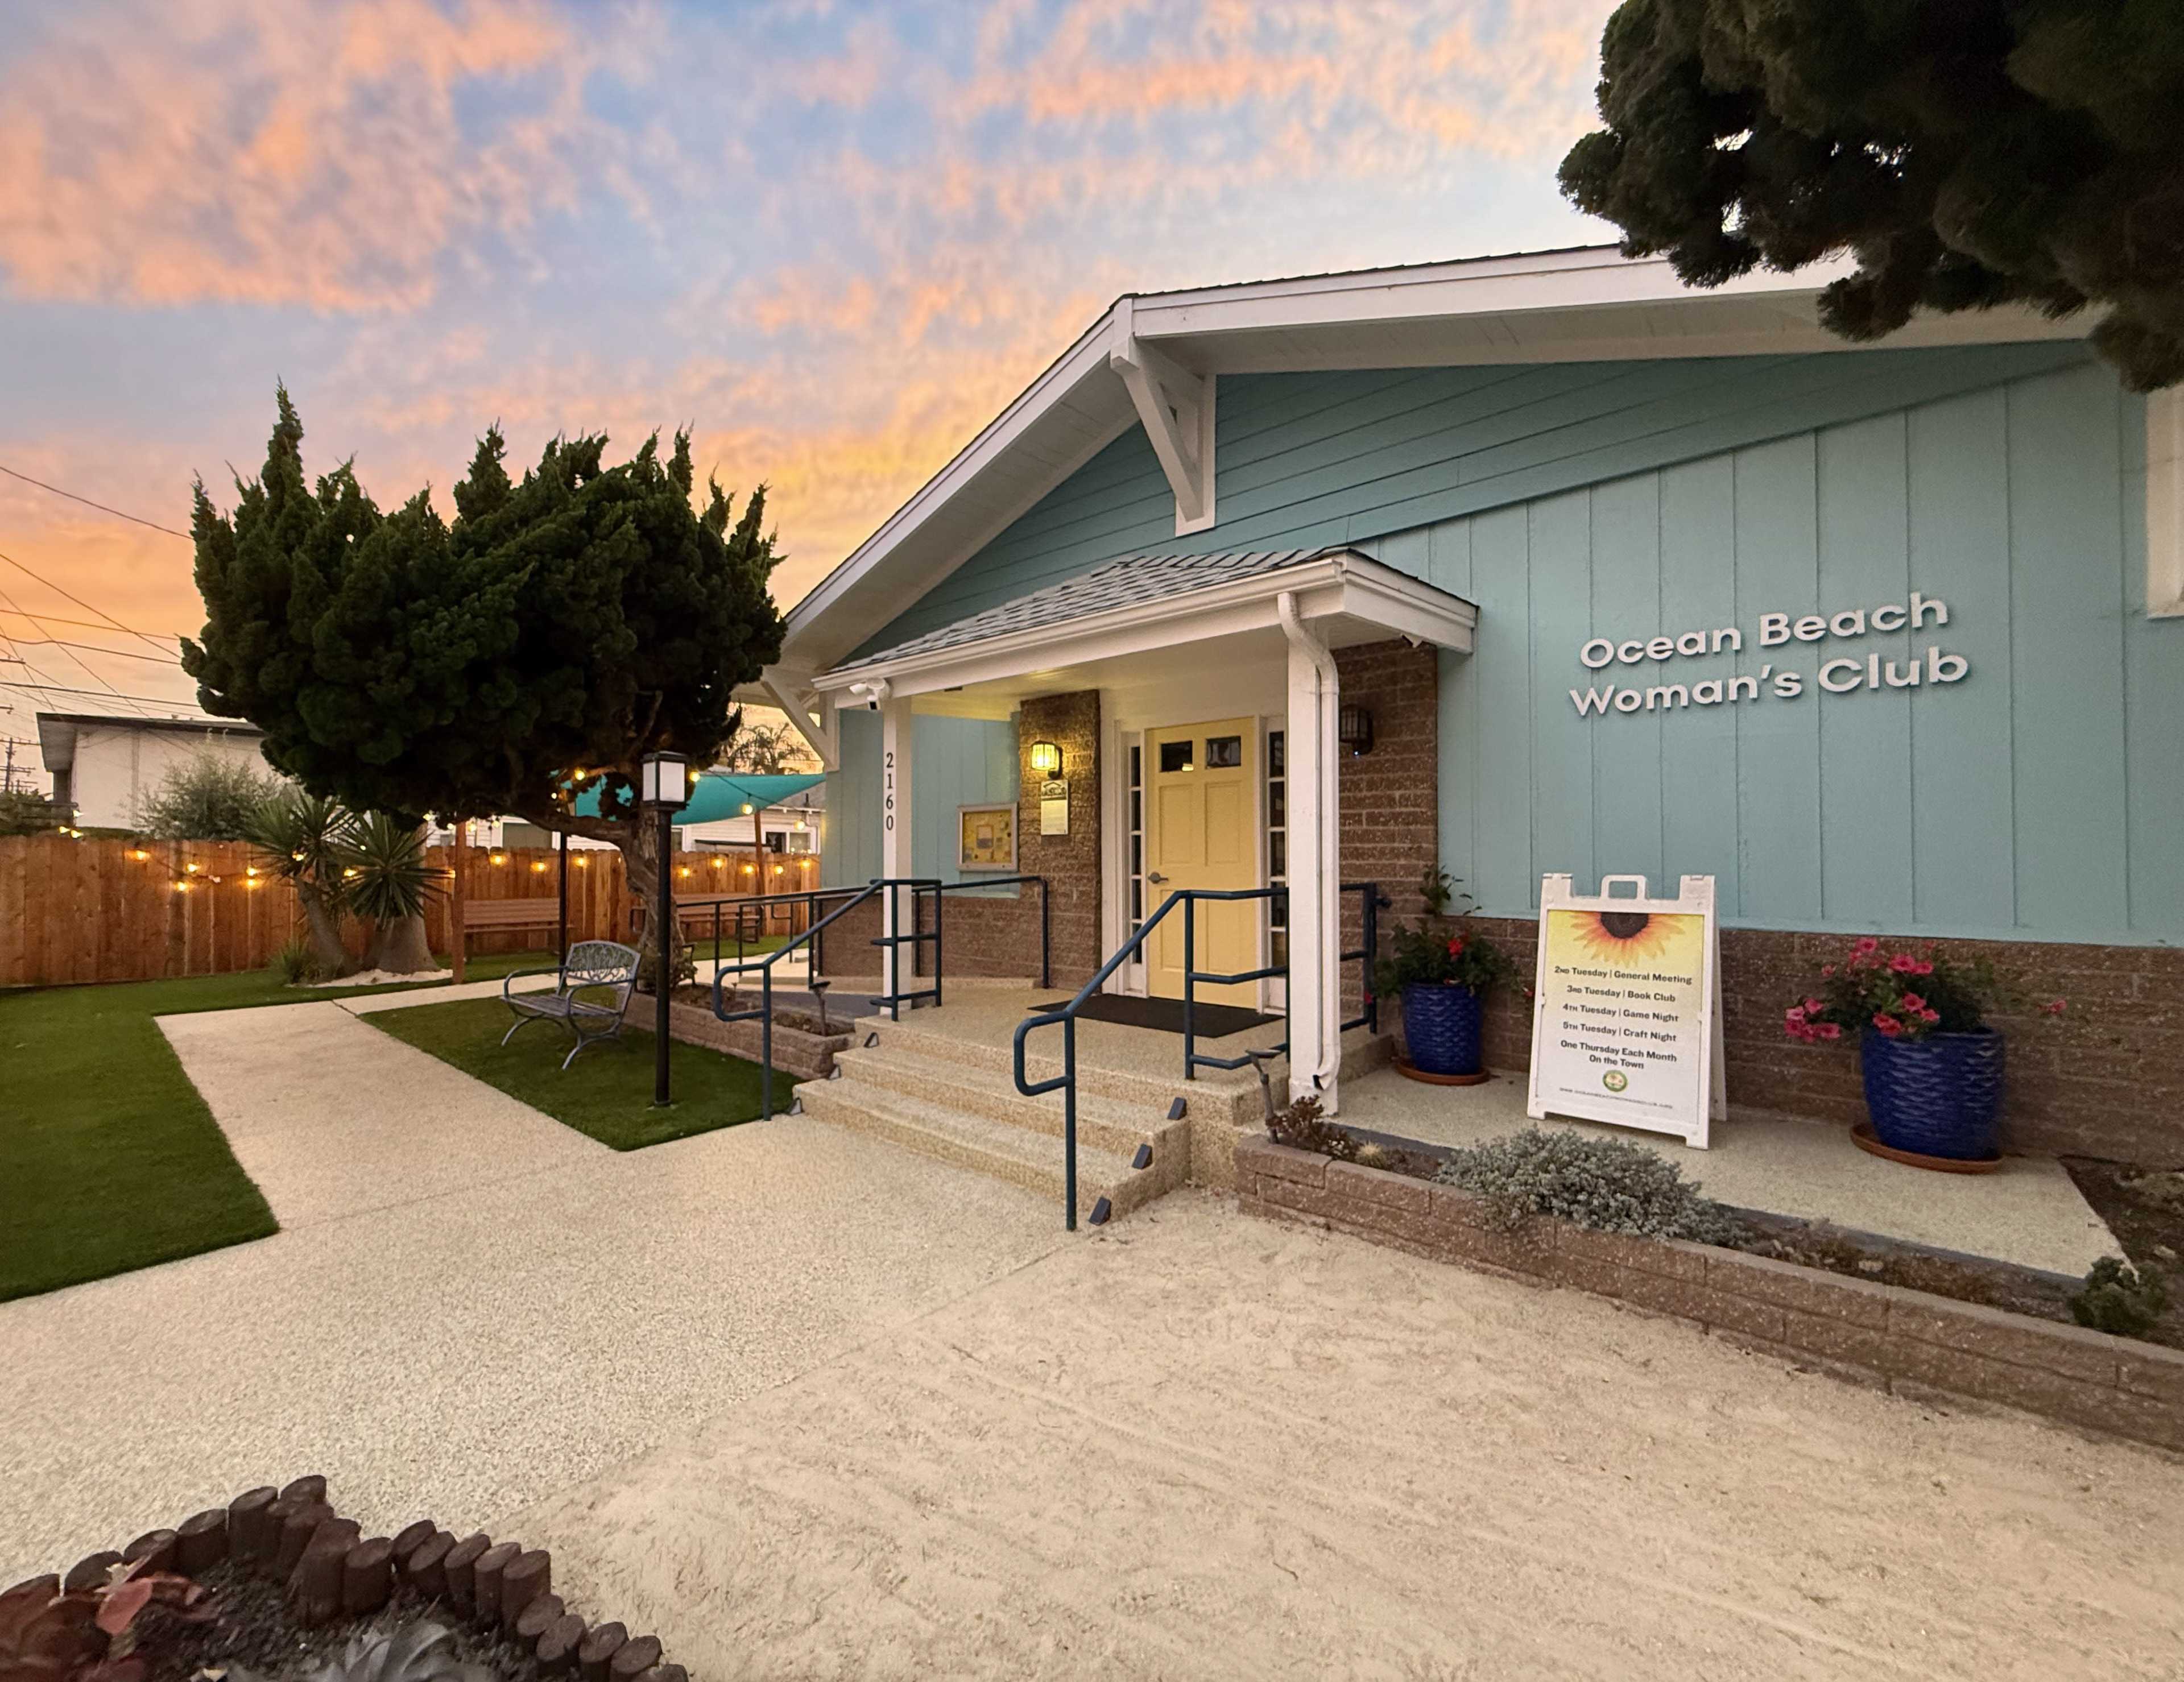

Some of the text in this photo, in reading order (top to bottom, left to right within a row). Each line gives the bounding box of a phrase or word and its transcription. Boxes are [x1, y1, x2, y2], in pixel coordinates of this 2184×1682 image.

[1580, 591, 1949, 669] Ocean Beach
[1569, 646, 1969, 717] Woman's Club
[886, 752, 894, 831] 2160
[1572, 967, 1607, 978] Tuesday
[1614, 970, 1650, 981] General
[1652, 973, 1693, 985] Meeting
[1584, 987, 1621, 999] Tuesday
[1627, 991, 1651, 1000] Book
[1653, 992, 1676, 1002] Club
[1580, 1005, 1617, 1017] Tuesday
[1623, 1009, 1650, 1020] Game
[1652, 1012, 1680, 1022] Night
[1580, 1024, 1617, 1036] Tuesday
[1623, 1028, 1648, 1039] Craft
[1650, 1031, 1677, 1042] Night
[1561, 1039, 1677, 1063] One Thursday Each Month
[1589, 1054, 1644, 1070] On the Town
